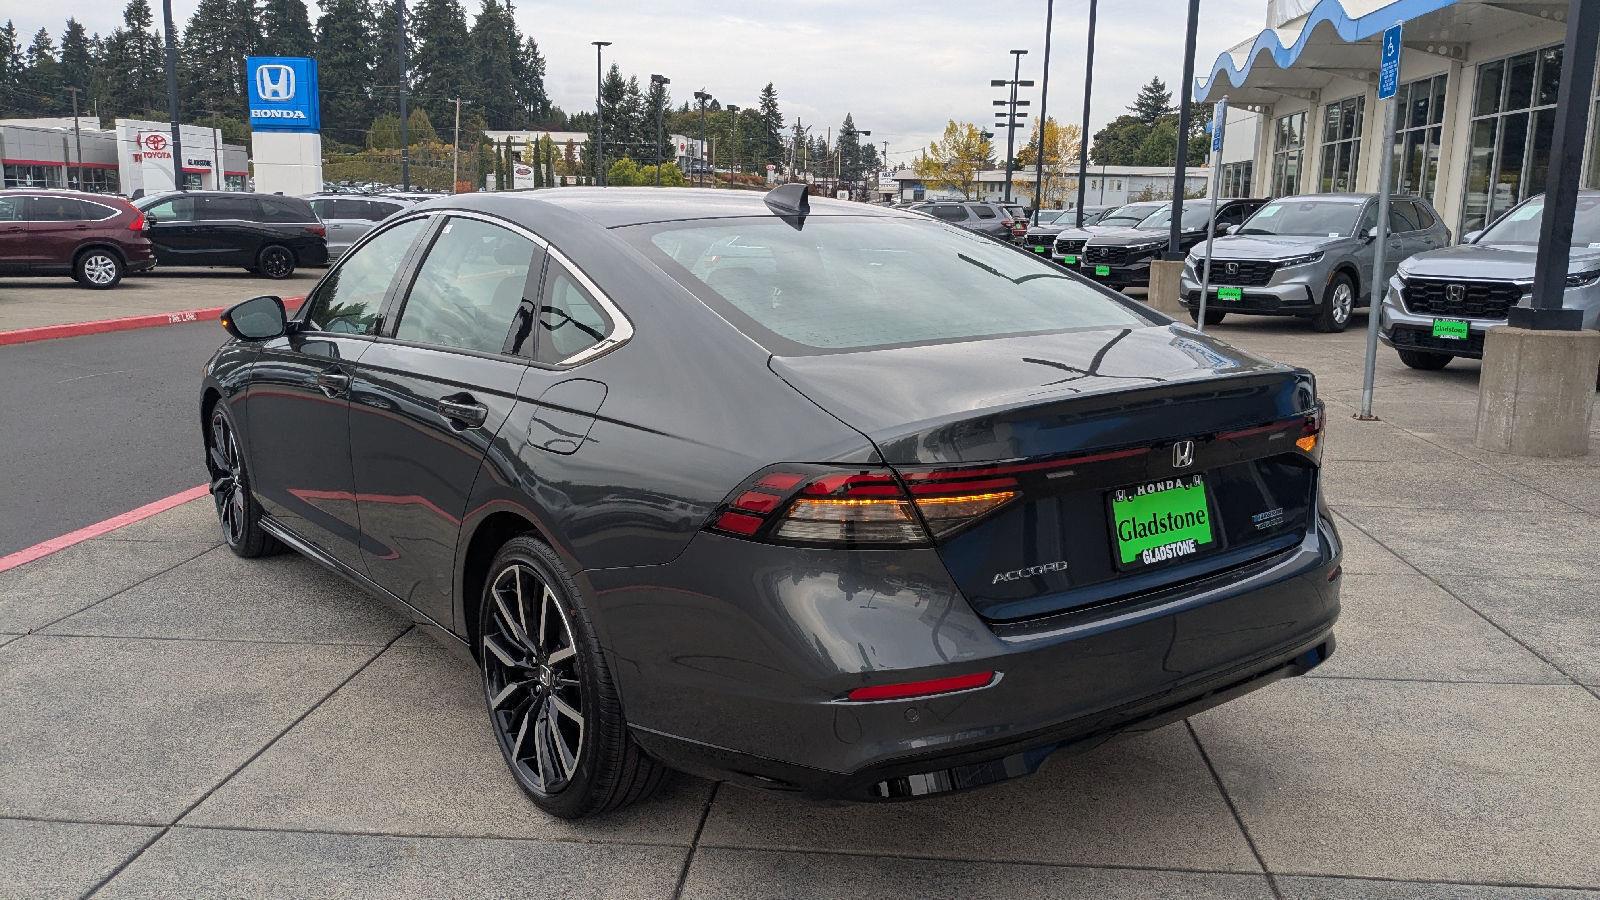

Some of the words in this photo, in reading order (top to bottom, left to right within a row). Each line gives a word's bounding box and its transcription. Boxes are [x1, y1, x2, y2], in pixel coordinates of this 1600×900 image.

[251, 109, 306, 119] HONDA
[143, 151, 172, 159] TOYOTA
[1137, 479, 1183, 496] HONDA
[1119, 509, 1205, 542] Gladstone
[1142, 539, 1196, 565] GLADSTONE
[992, 561, 1067, 584] ACCORD
